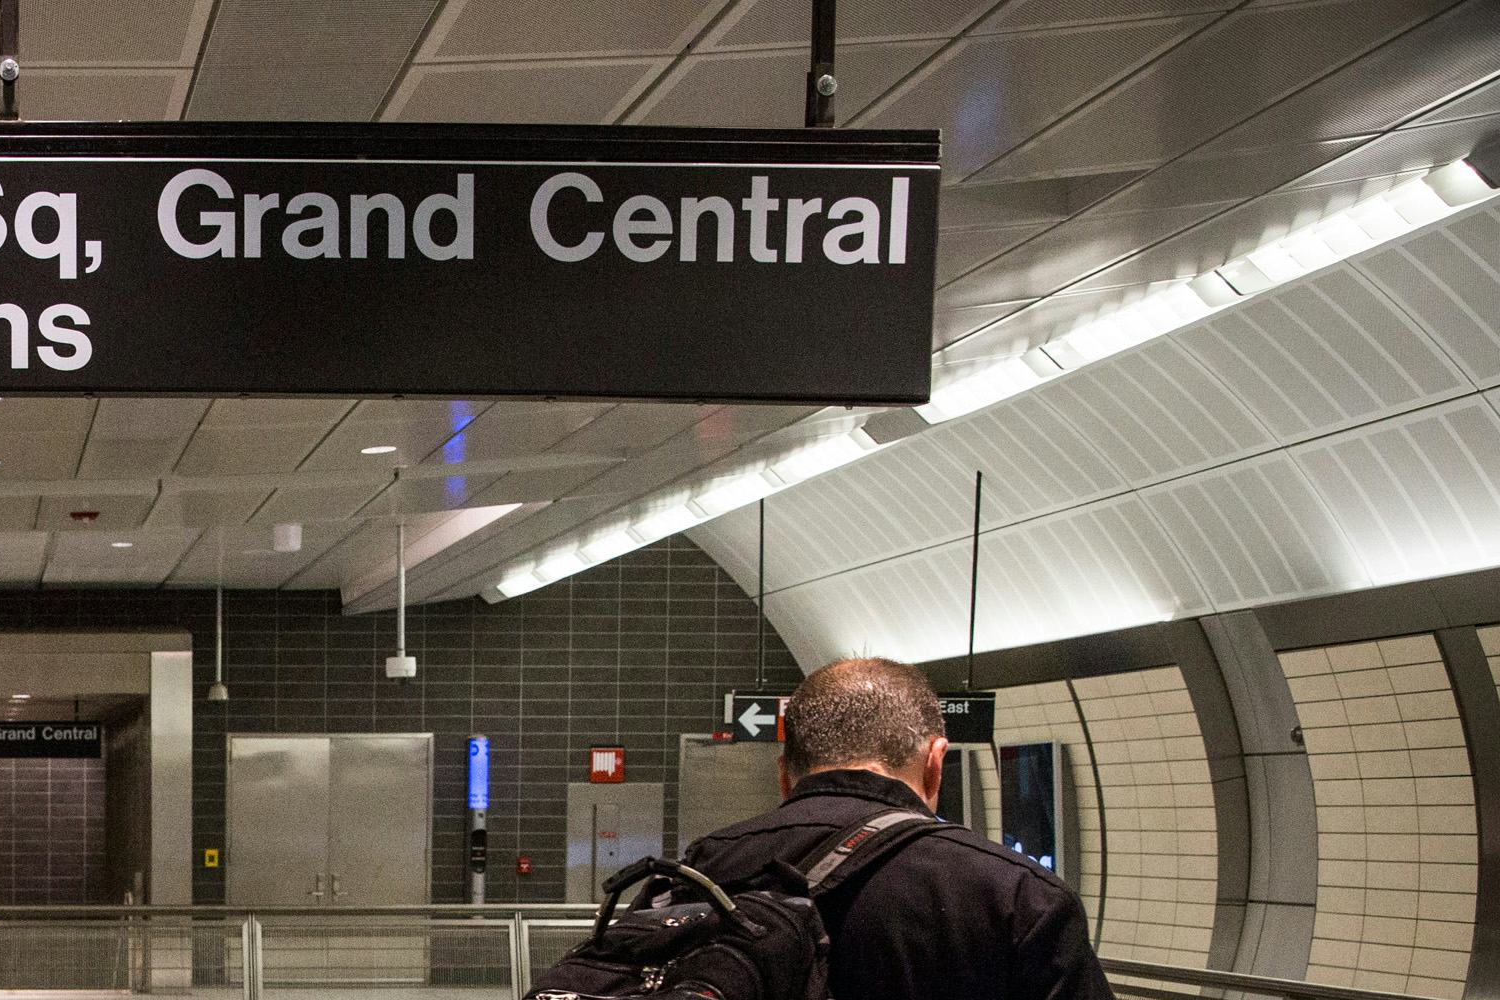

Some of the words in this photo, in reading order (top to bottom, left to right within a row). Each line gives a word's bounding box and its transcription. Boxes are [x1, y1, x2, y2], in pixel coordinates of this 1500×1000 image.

[156, 167, 475, 262] Grand
[528, 171, 911, 265] Central
[939, 700, 970, 714] East
[42, 726, 97, 740] Central
